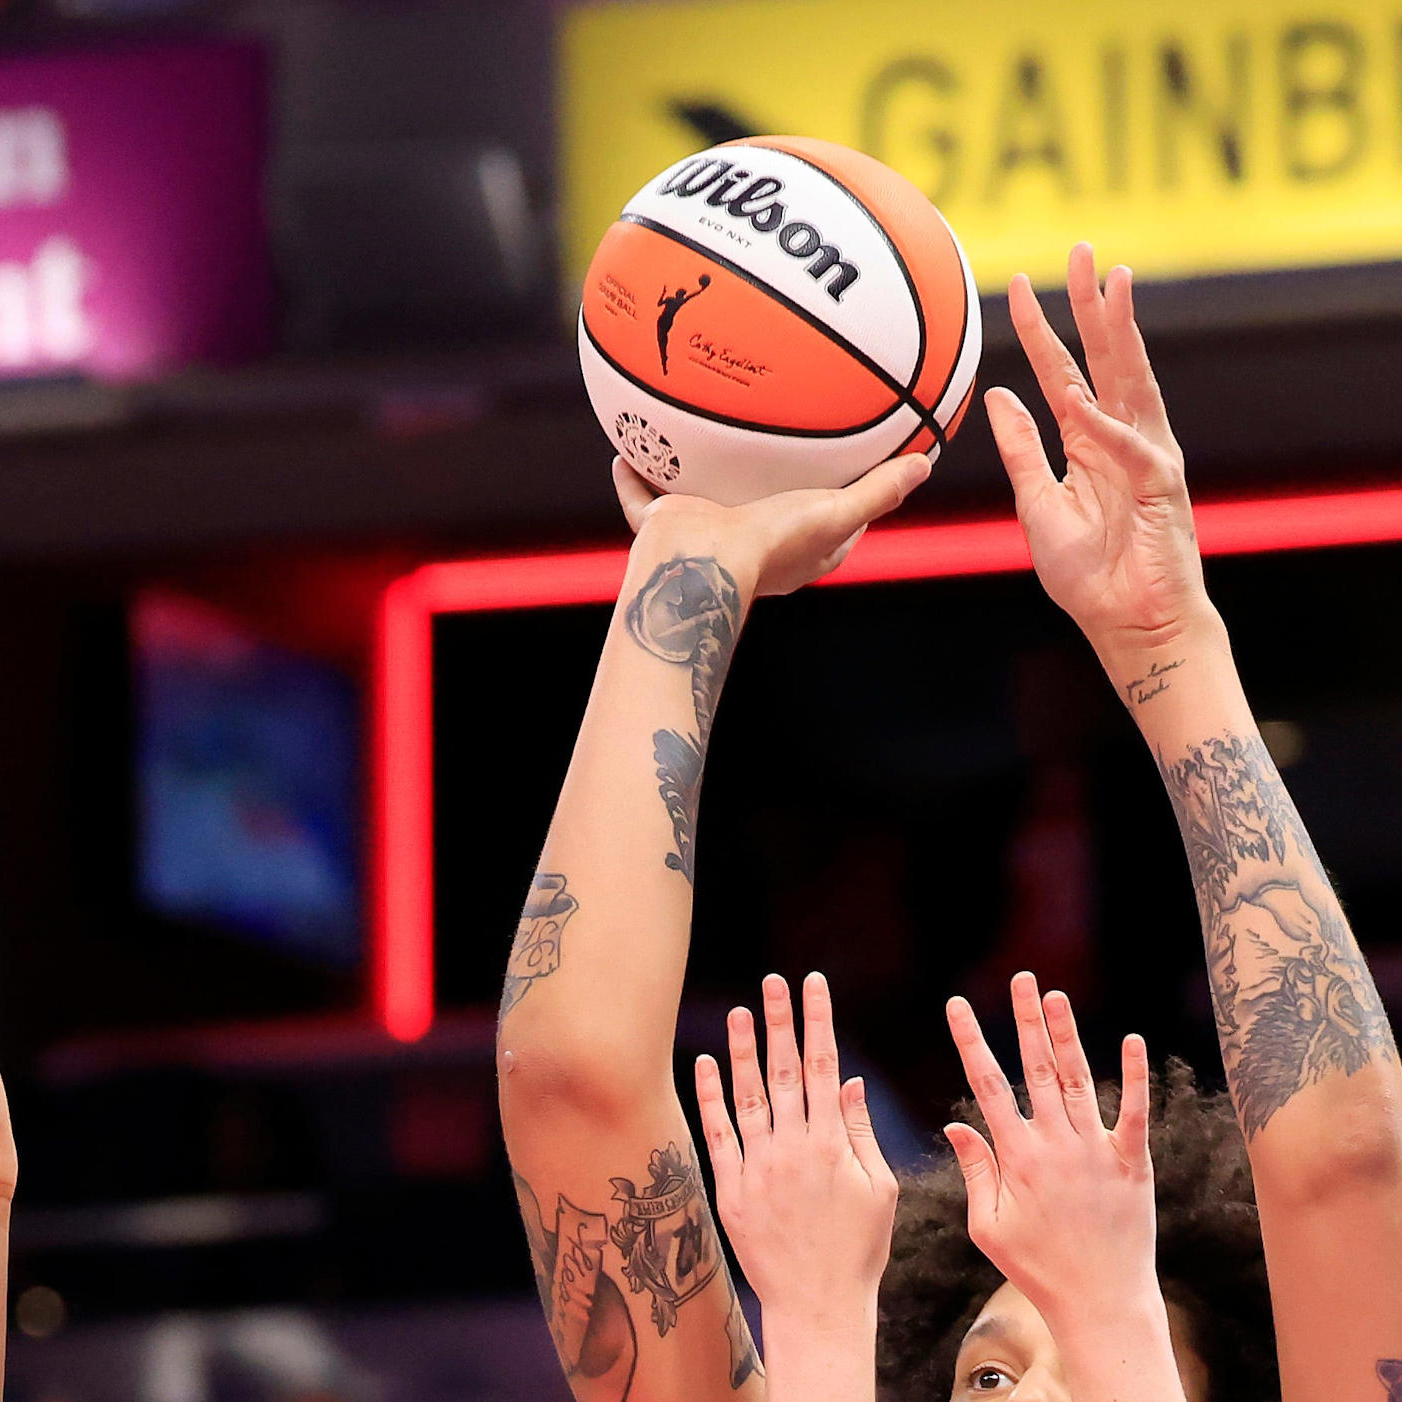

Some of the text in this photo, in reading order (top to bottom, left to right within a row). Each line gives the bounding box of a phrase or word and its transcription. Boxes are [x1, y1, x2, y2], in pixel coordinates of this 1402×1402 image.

[658, 156, 861, 304] Wilson
[698, 216, 753, 248] EVO NXT
